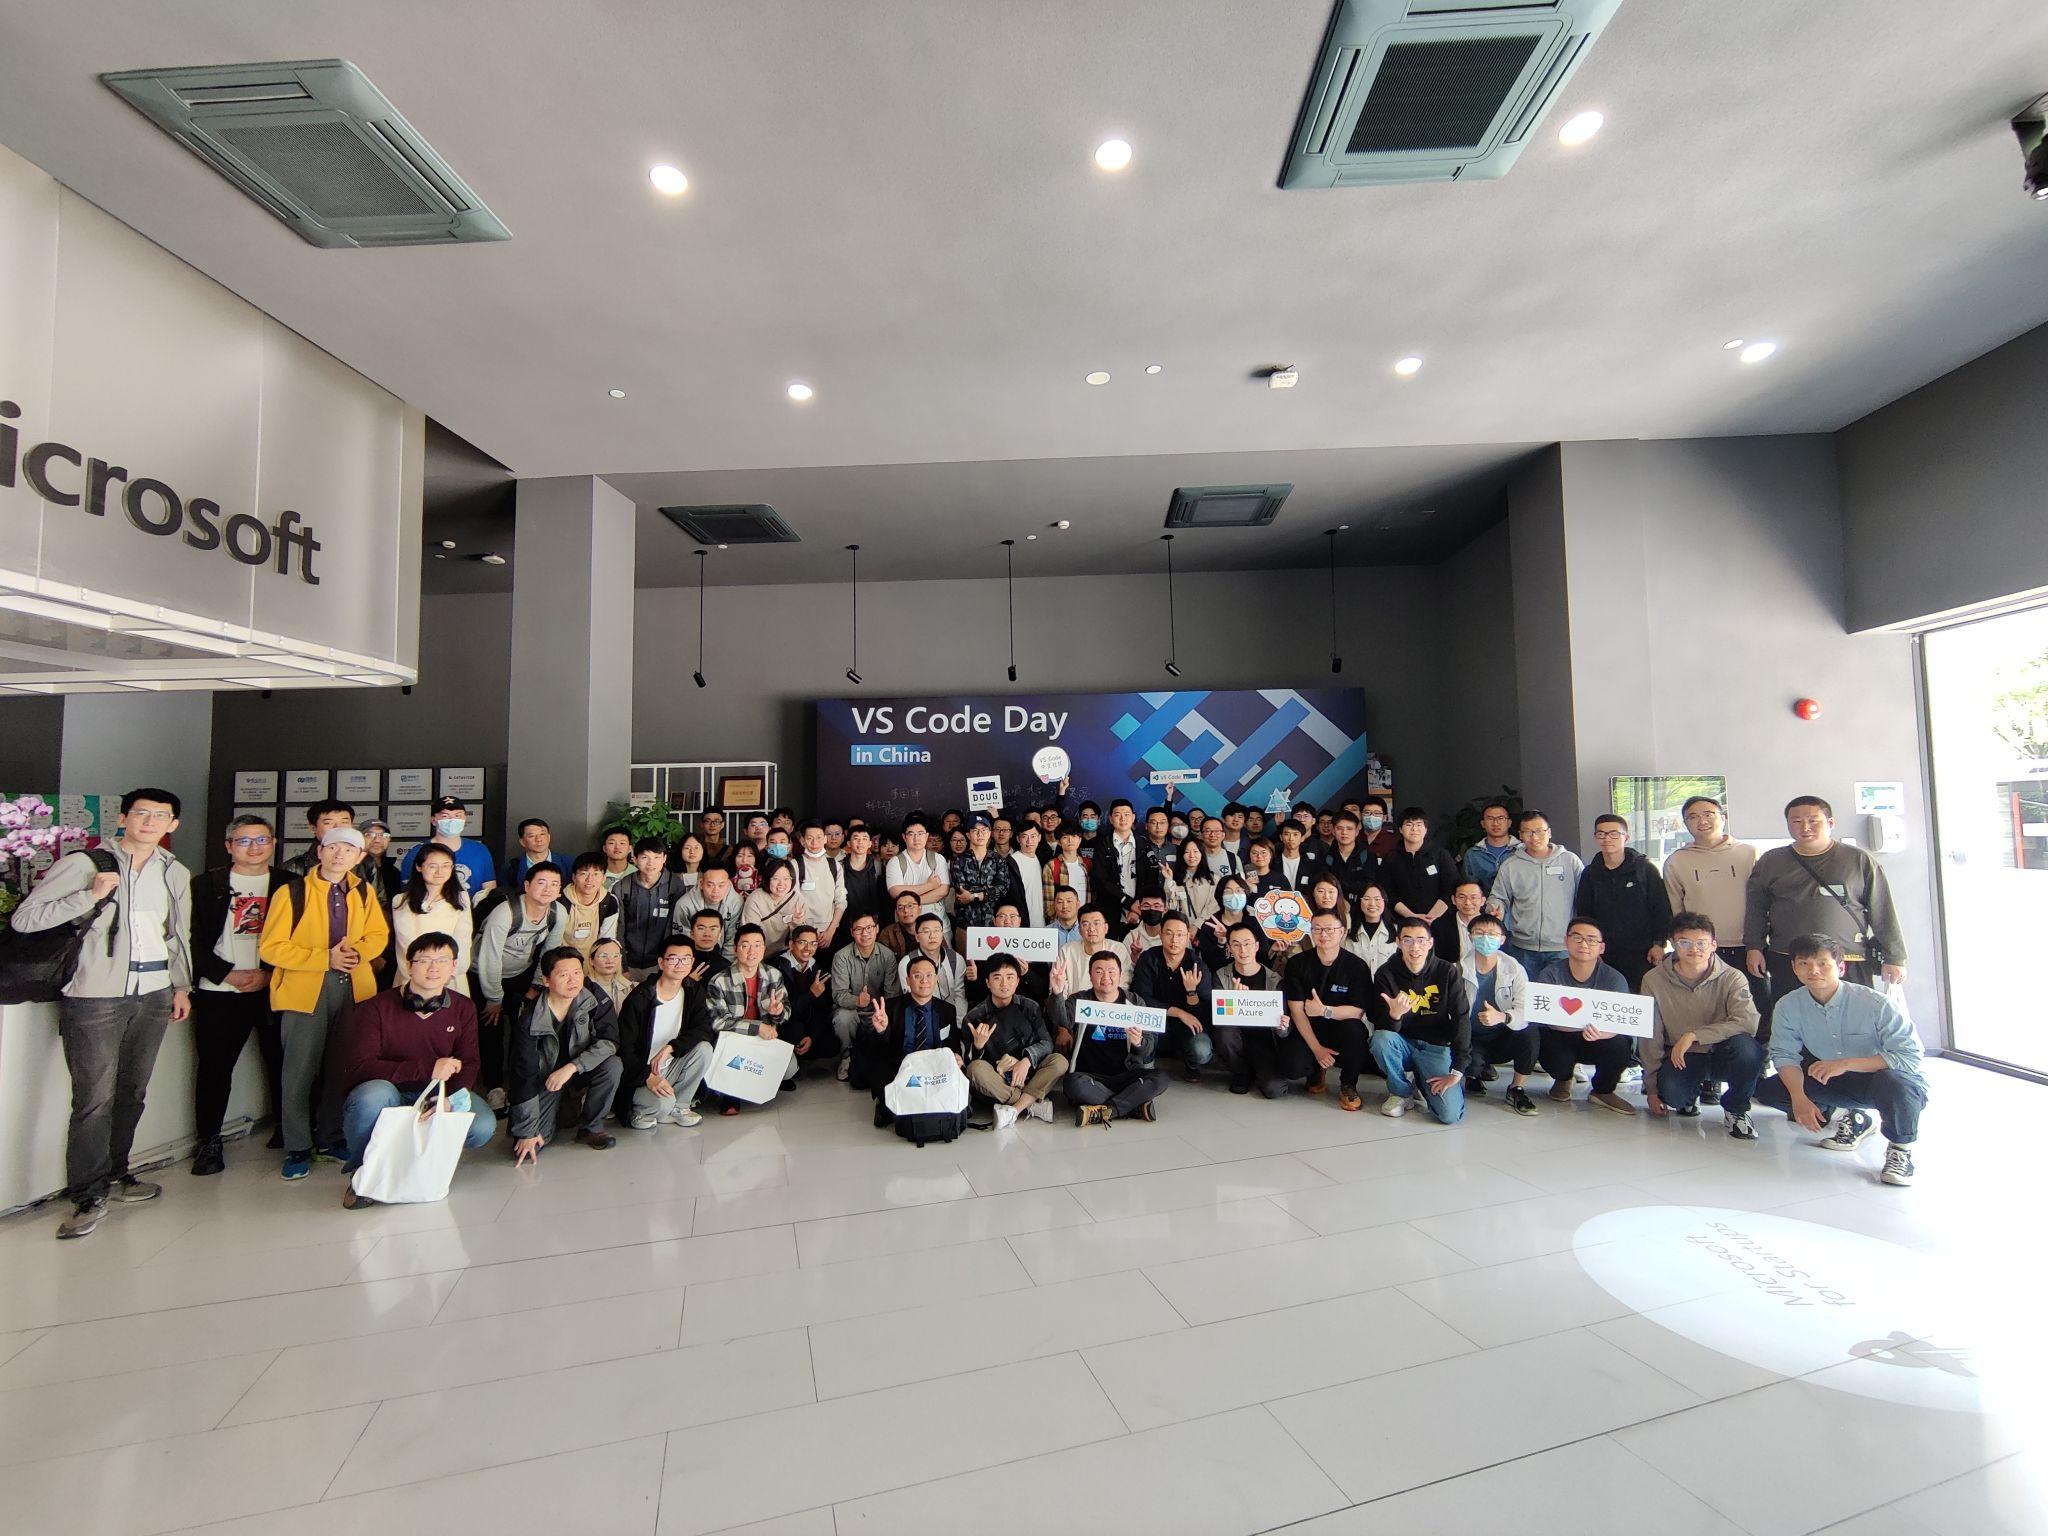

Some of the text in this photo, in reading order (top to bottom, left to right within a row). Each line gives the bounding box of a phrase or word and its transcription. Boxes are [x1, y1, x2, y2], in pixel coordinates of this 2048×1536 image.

[852, 705, 1068, 740] VS Code Day
[856, 747, 931, 763] in China
[973, 792, 998, 802] DCUG
[977, 937, 1051, 949] I VS Code
[1237, 998, 1279, 1007] Microsoft
[1533, 995, 1550, 1012] 我
[1592, 1000, 1642, 1015] VS Code
[1094, 1009, 1106, 1018] VS
[1108, 1010, 1132, 1021] Code
[1237, 1008, 1264, 1016] Azure
[1592, 1012, 1640, 1026] 中文社区
[1685, 1235, 1814, 1305] Microsoft
